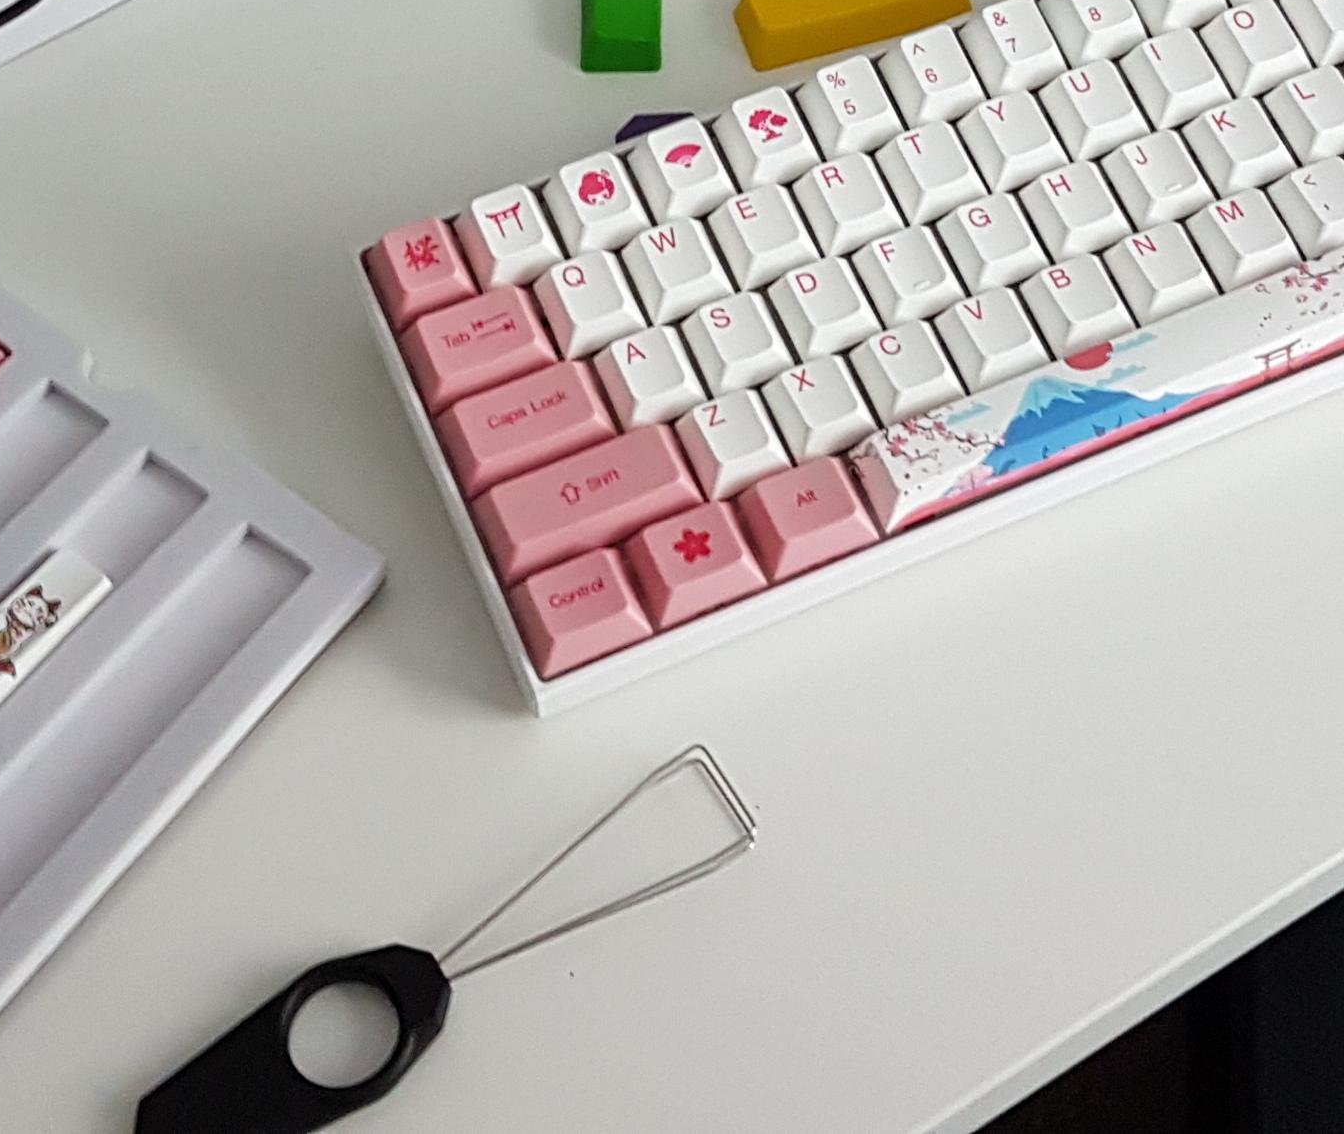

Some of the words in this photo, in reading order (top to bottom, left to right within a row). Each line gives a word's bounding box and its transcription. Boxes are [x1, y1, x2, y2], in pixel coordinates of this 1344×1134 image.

[992, 11, 1008, 27] &
[1087, 6, 1102, 22] 8
[1232, 10, 1255, 32] O
[1005, 37, 1018, 54] 7
[1149, 42, 1162, 61] I
[826, 71, 846, 89] %
[924, 67, 938, 84] 6
[1067, 71, 1092, 94] U
[1292, 82, 1316, 101] L
[843, 98, 857, 116] 5
[985, 100, 1005, 122] Y
[1210, 109, 1237, 132] K
[903, 132, 922, 155] T
[1135, 144, 1149, 166] J
[820, 165, 845, 189] R
[1046, 173, 1072, 197] H
[734, 197, 758, 221] E
[967, 207, 993, 228] G
[1214, 201, 1245, 224] M
[647, 226, 677, 254] W
[1133, 234, 1158, 256] N
[878, 240, 895, 263] F
[561, 265, 587, 288] Q
[794, 272, 818, 295] D
[1050, 267, 1072, 291] B
[709, 307, 732, 329] S
[962, 299, 984, 322] V
[443, 329, 471, 350] Tab
[878, 334, 902, 356] C
[626, 341, 647, 366] A
[789, 368, 815, 393] X
[487, 404, 528, 429] Caps
[530, 389, 568, 414] Lock
[704, 405, 727, 427] Z
[586, 468, 620, 492] Shift
[795, 489, 817, 507] Alt
[549, 577, 605, 607] Control
